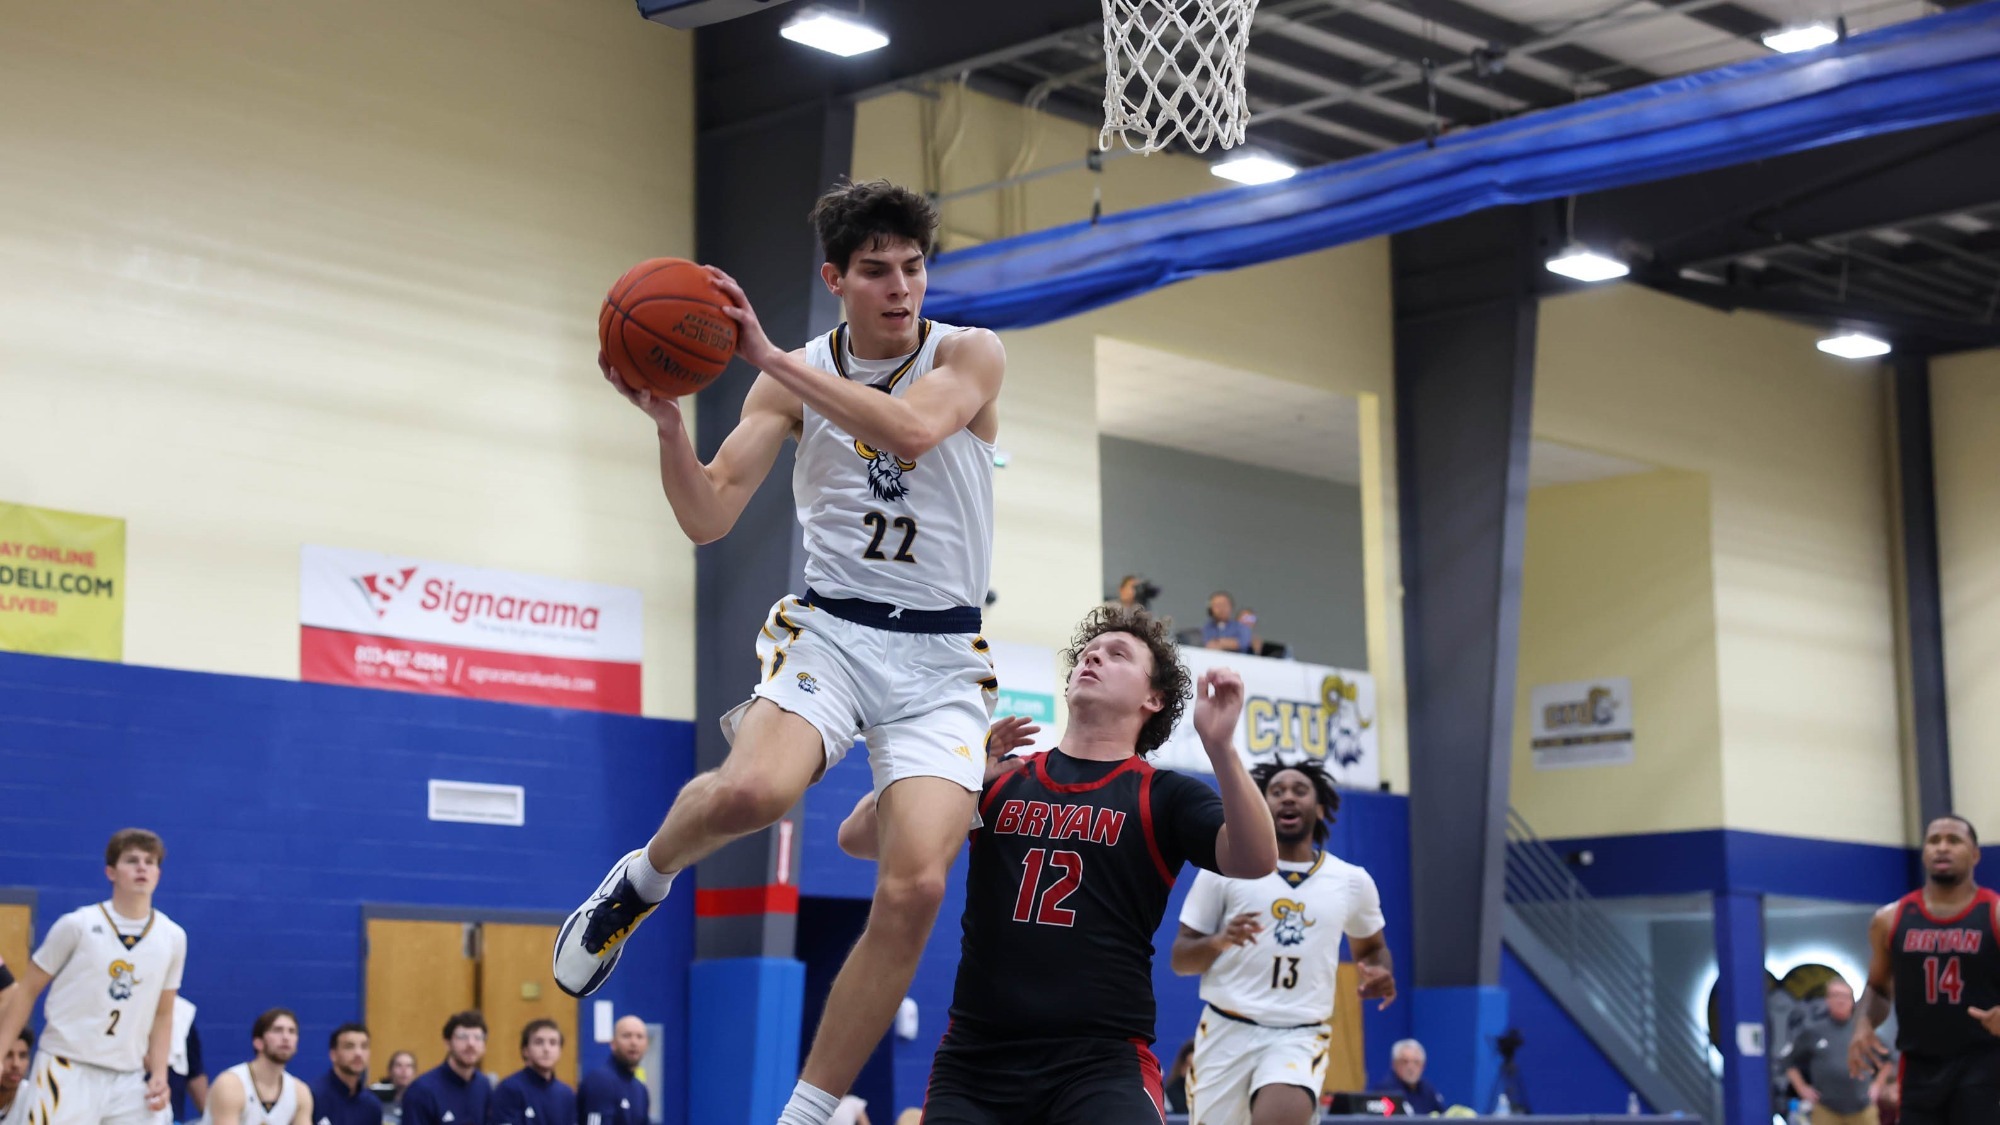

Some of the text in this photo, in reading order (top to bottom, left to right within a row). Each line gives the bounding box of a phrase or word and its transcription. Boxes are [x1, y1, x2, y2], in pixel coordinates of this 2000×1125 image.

[27, 544, 97, 569] ONLINE
[861, 511, 918, 564] 22
[0, 565, 113, 598] DELI.COM
[420, 577, 601, 631] Signarama
[1246, 696, 1328, 759] CIU
[994, 799, 1127, 847] BRYAN
[1012, 847, 1083, 927] 12
[1902, 927, 1983, 955] BRYAN
[1271, 955, 1301, 990] 13
[1922, 955, 1965, 1005] 14
[105, 1009, 120, 1036] 2
